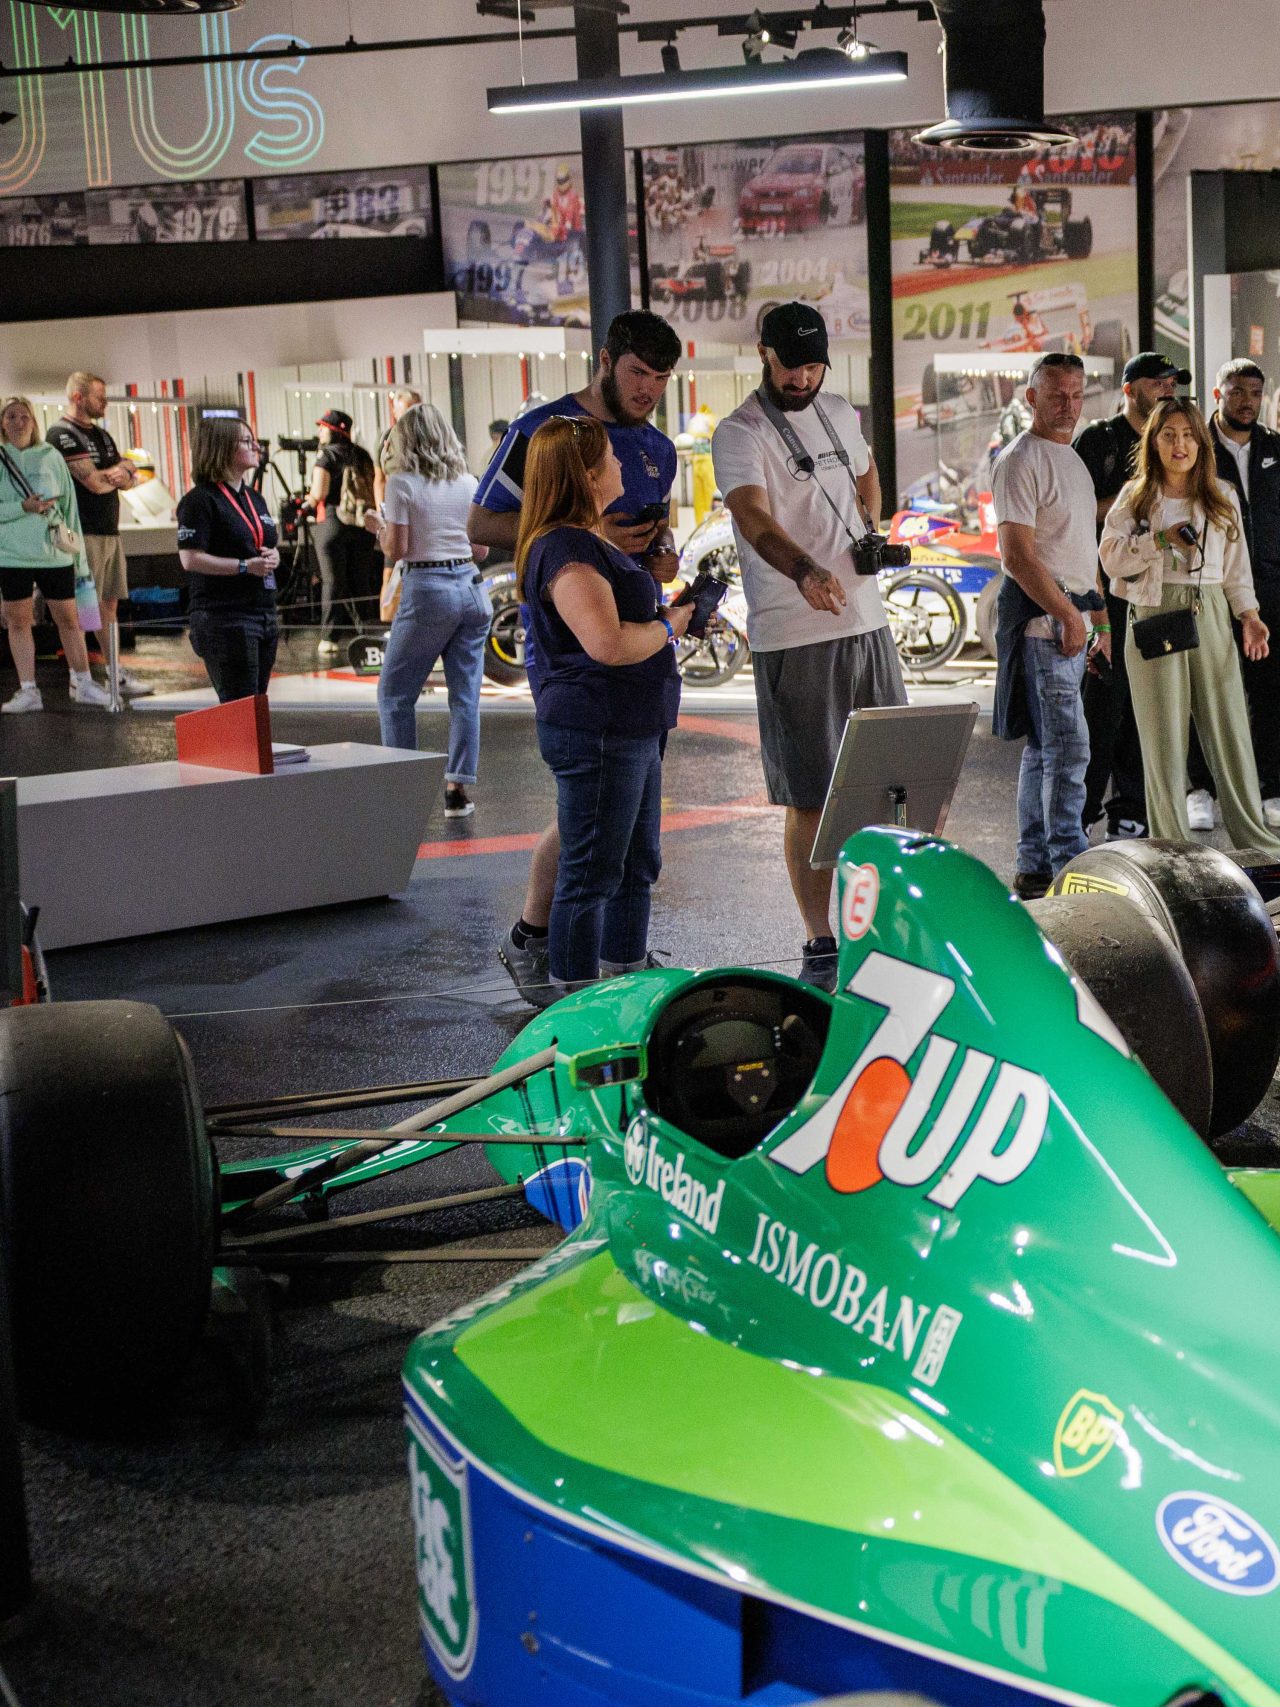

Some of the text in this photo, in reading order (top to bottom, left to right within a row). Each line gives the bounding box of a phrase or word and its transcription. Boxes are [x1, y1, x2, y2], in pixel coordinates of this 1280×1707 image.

[936, 162, 1004, 185] Santander
[665, 296, 748, 323] 2008
[902, 300, 992, 341] 2011
[782, 427, 802, 455] Canon
[645, 1135, 726, 1235] Ireland
[746, 1211, 931, 1362] ISMOBAN
[1060, 1403, 1112, 1457] BP
[1171, 1502, 1264, 1581] Ford
